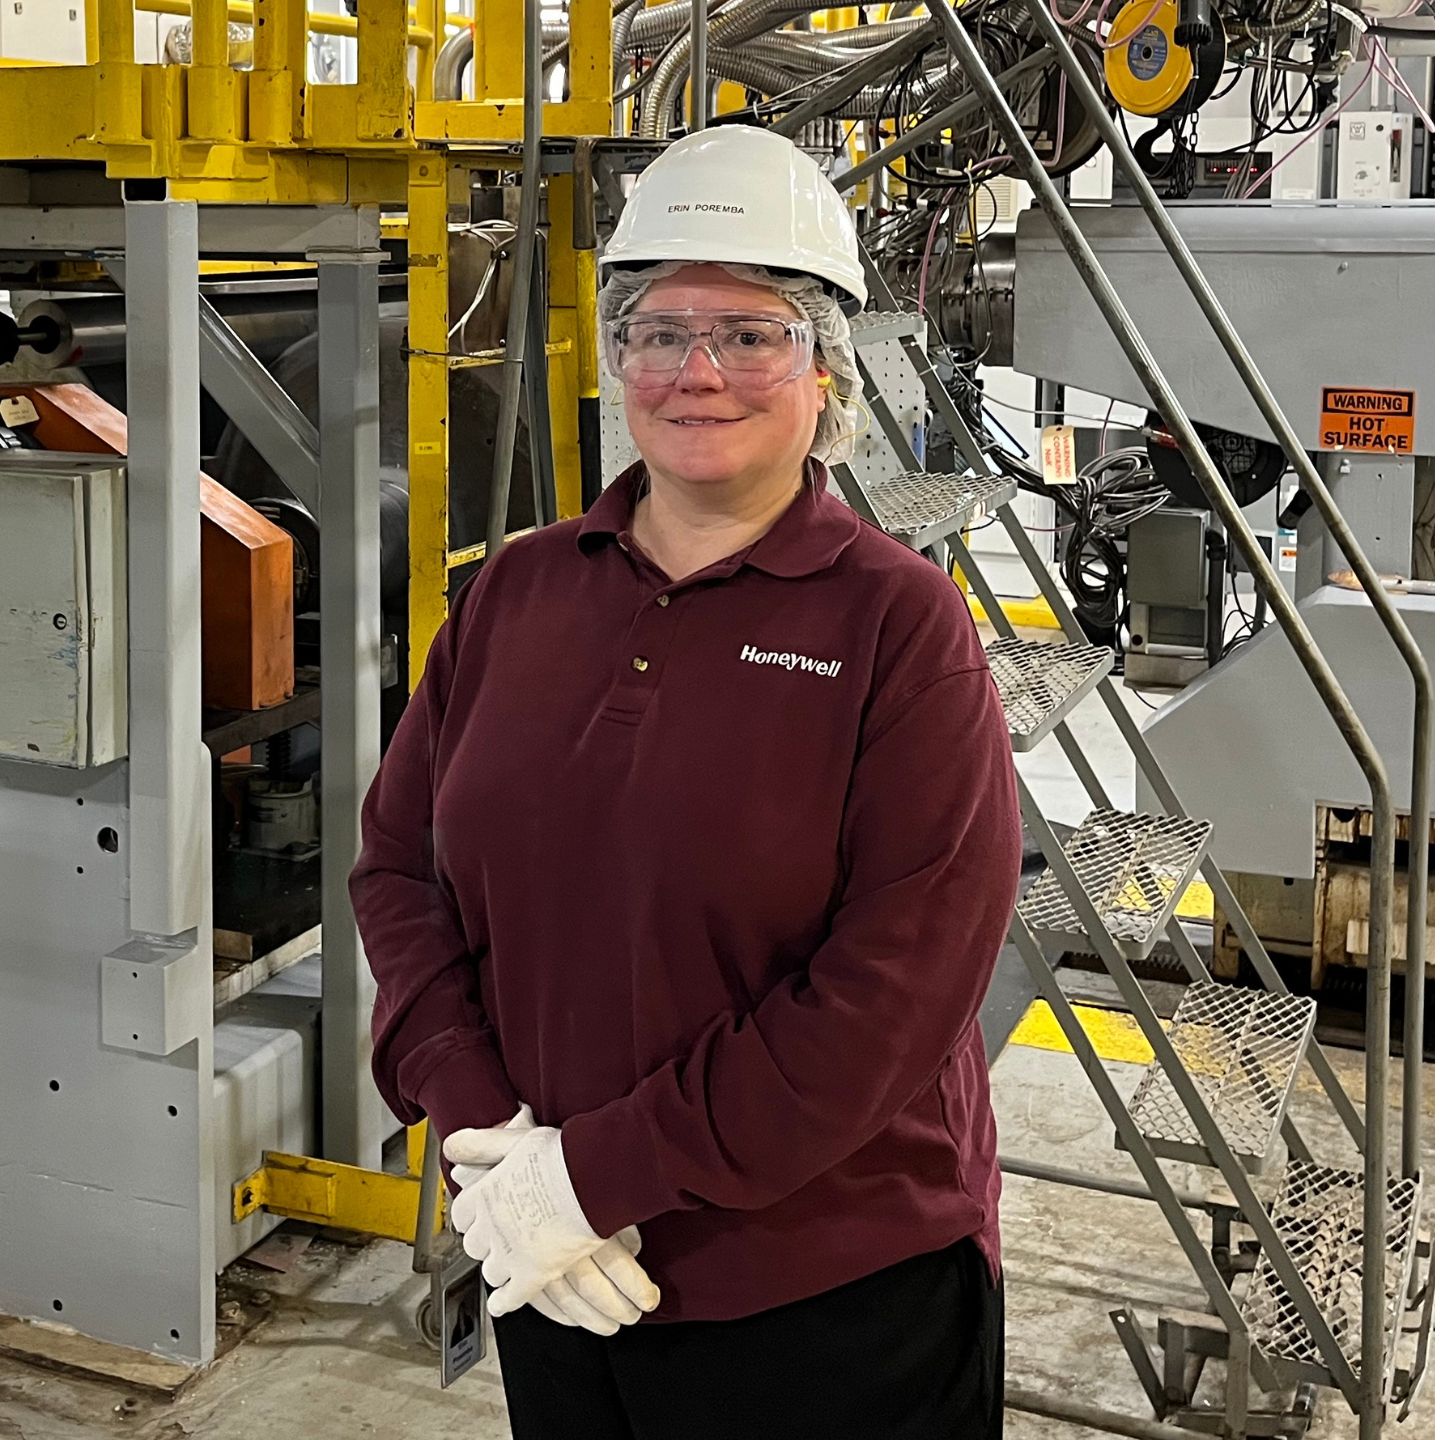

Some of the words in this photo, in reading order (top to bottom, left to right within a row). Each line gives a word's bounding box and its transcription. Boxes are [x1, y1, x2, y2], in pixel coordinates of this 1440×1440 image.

[668, 204, 690, 213] ERIN
[695, 204, 745, 214] POREMBA
[1333, 394, 1403, 411] WARNING
[1350, 417, 1385, 432] HOT
[1324, 432, 1408, 449] SURFACE
[740, 644, 842, 678] Honeywell
